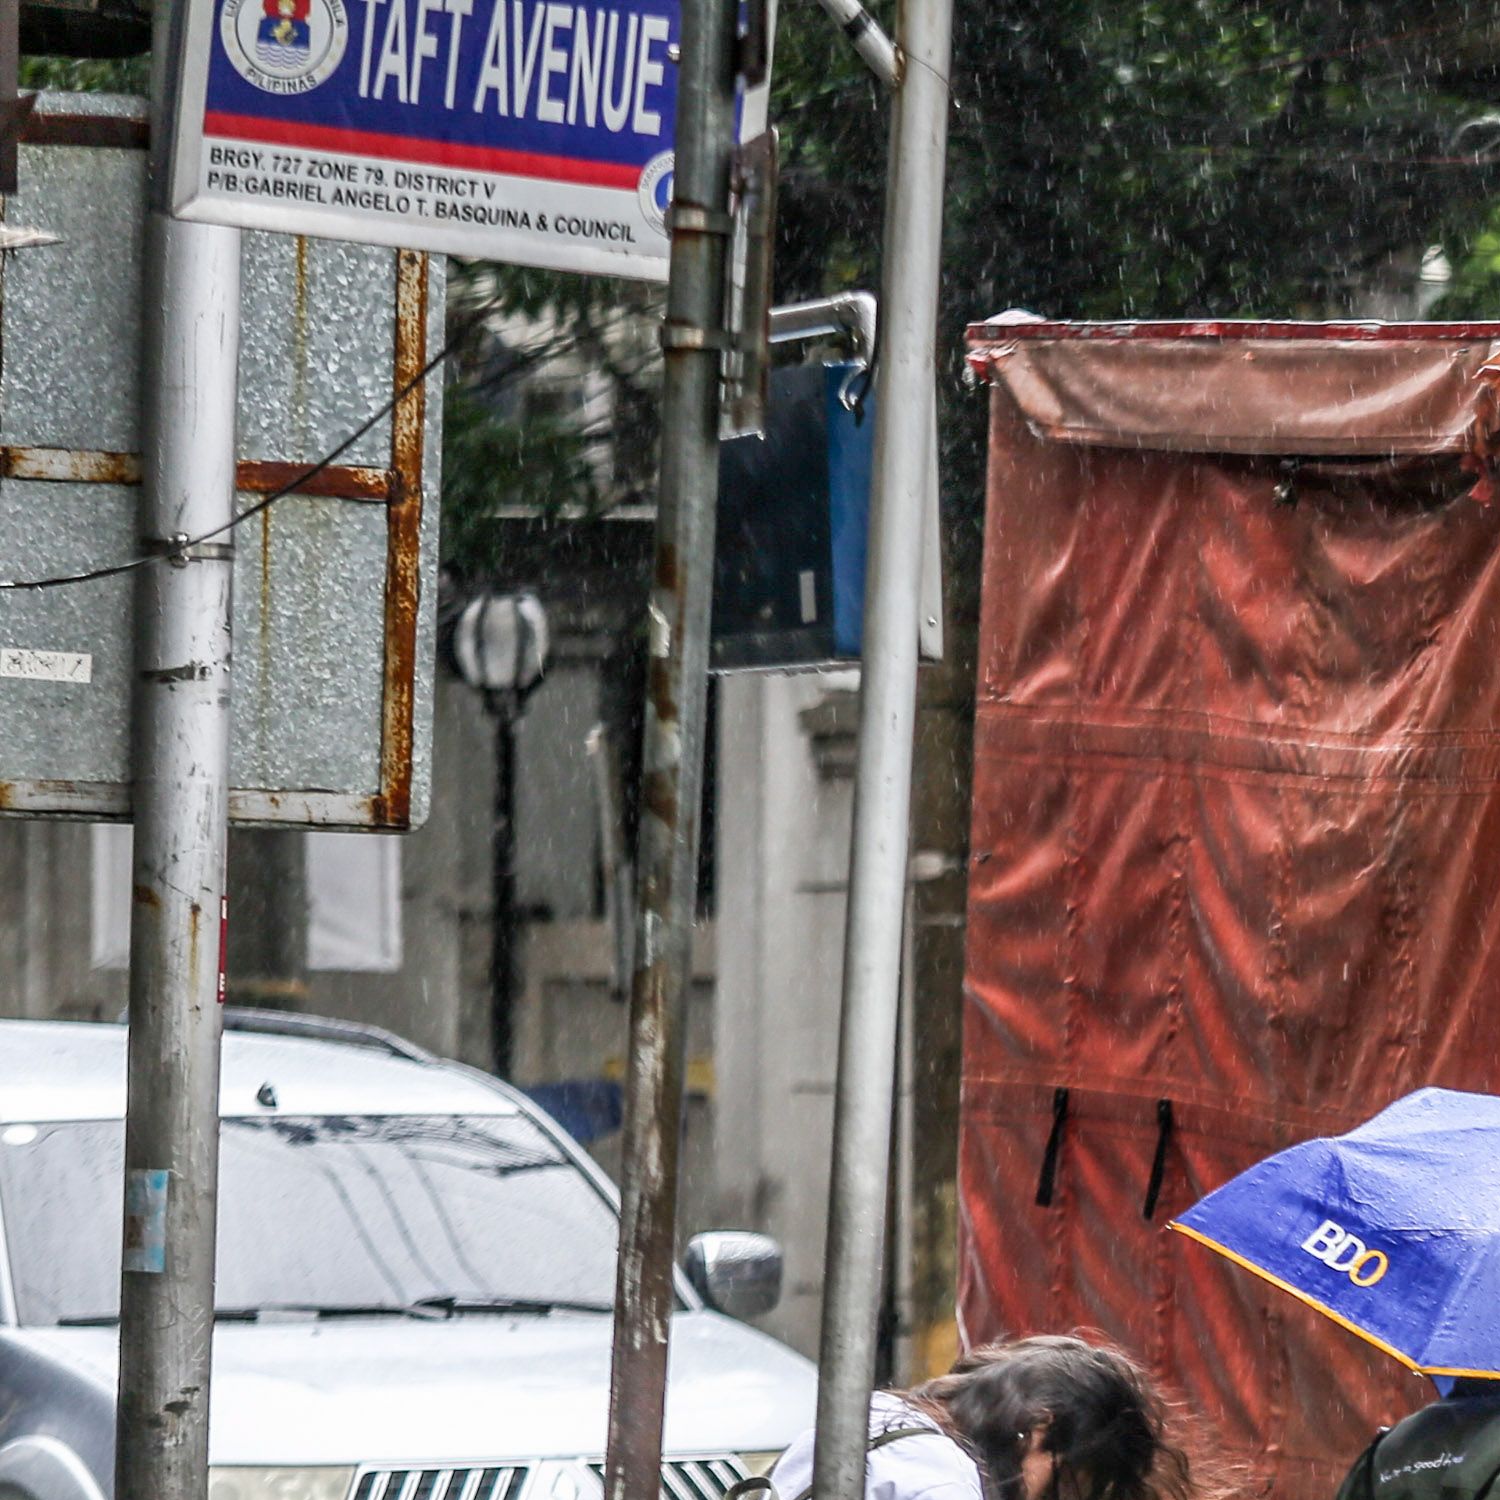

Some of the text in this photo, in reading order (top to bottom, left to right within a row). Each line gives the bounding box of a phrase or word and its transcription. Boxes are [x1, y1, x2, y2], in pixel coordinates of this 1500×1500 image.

[244, 66, 318, 95] PILIPINAS
[358, 0, 669, 136] TAFT AVENUE
[209, 146, 265, 171] BRGY.
[271, 155, 304, 176] 727
[306, 160, 359, 183] ZONE
[394, 168, 481, 198] DISTRICT
[483, 182, 497, 199] V
[330, 188, 411, 214] ANGELO
[416, 198, 430, 217] T.
[434, 200, 532, 230] BASQUINA
[536, 213, 549, 232] &
[554, 216, 637, 243] COUNCIL
[1300, 1218, 1389, 1288] BDO
